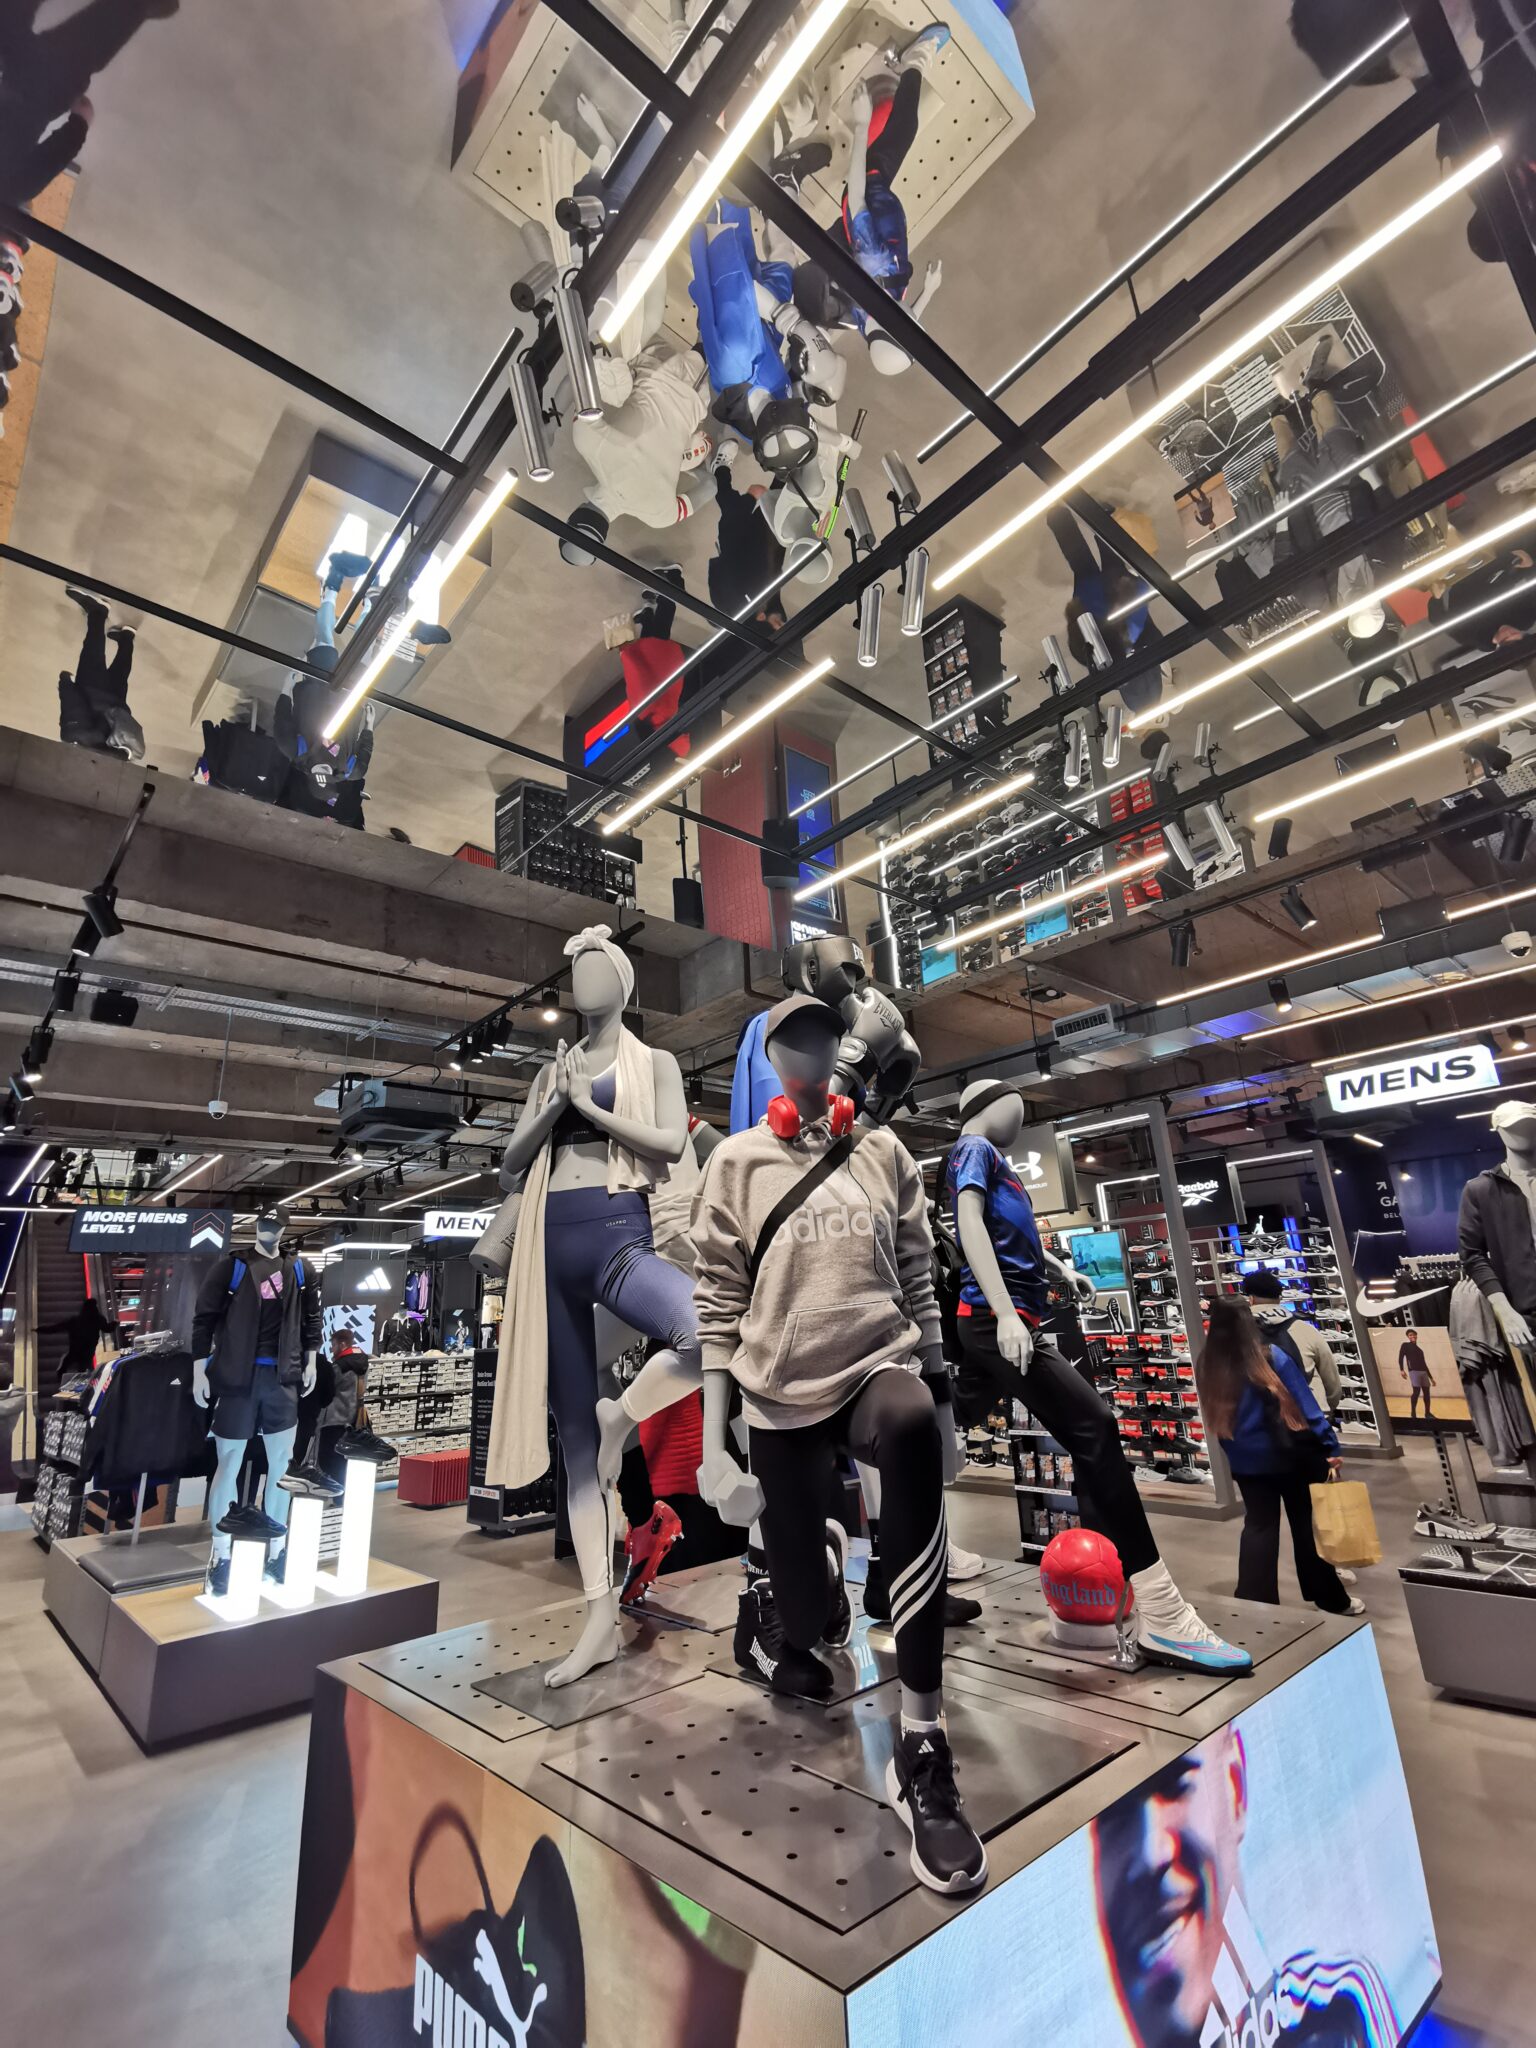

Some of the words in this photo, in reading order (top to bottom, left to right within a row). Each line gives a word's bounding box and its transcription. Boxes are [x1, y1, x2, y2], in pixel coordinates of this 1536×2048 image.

[873, 1001, 902, 1034] EVERLAST
[1339, 1055, 1476, 1101] MENS
[1177, 1180, 1219, 1194] Reebok
[80, 1224, 125, 1233] LEVEL
[127, 1225, 136, 1234] 1
[82, 1211, 138, 1223] MORE
[137, 1213, 189, 1224] MENS
[436, 1216, 488, 1231] MEN
[1041, 1571, 1117, 1607] England
[413, 1953, 511, 2048] PUM
